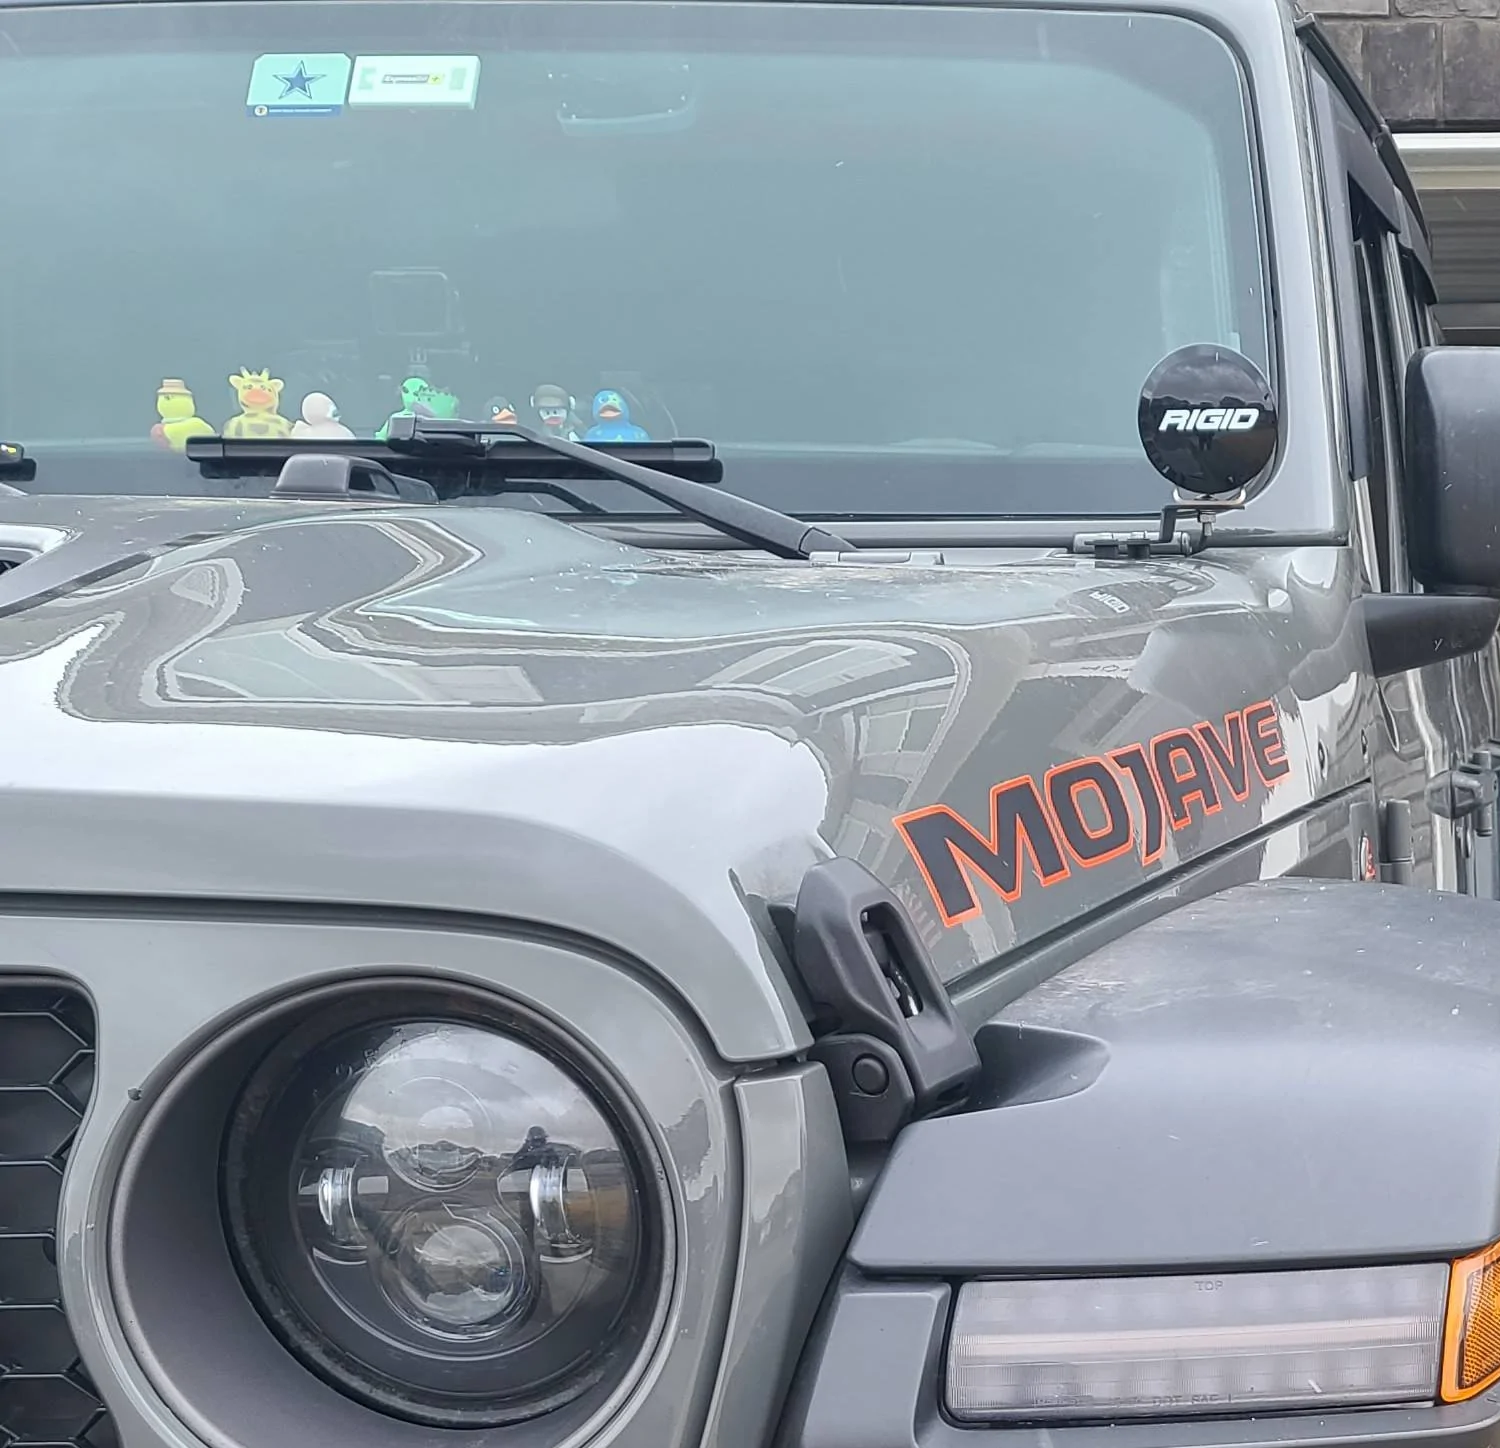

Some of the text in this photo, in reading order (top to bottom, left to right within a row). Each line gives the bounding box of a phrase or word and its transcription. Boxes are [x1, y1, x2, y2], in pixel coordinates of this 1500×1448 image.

[1158, 408, 1260, 431] RIGID
[892, 699, 1292, 928] MOJAVE
[1194, 1280, 1224, 1291] TOP
